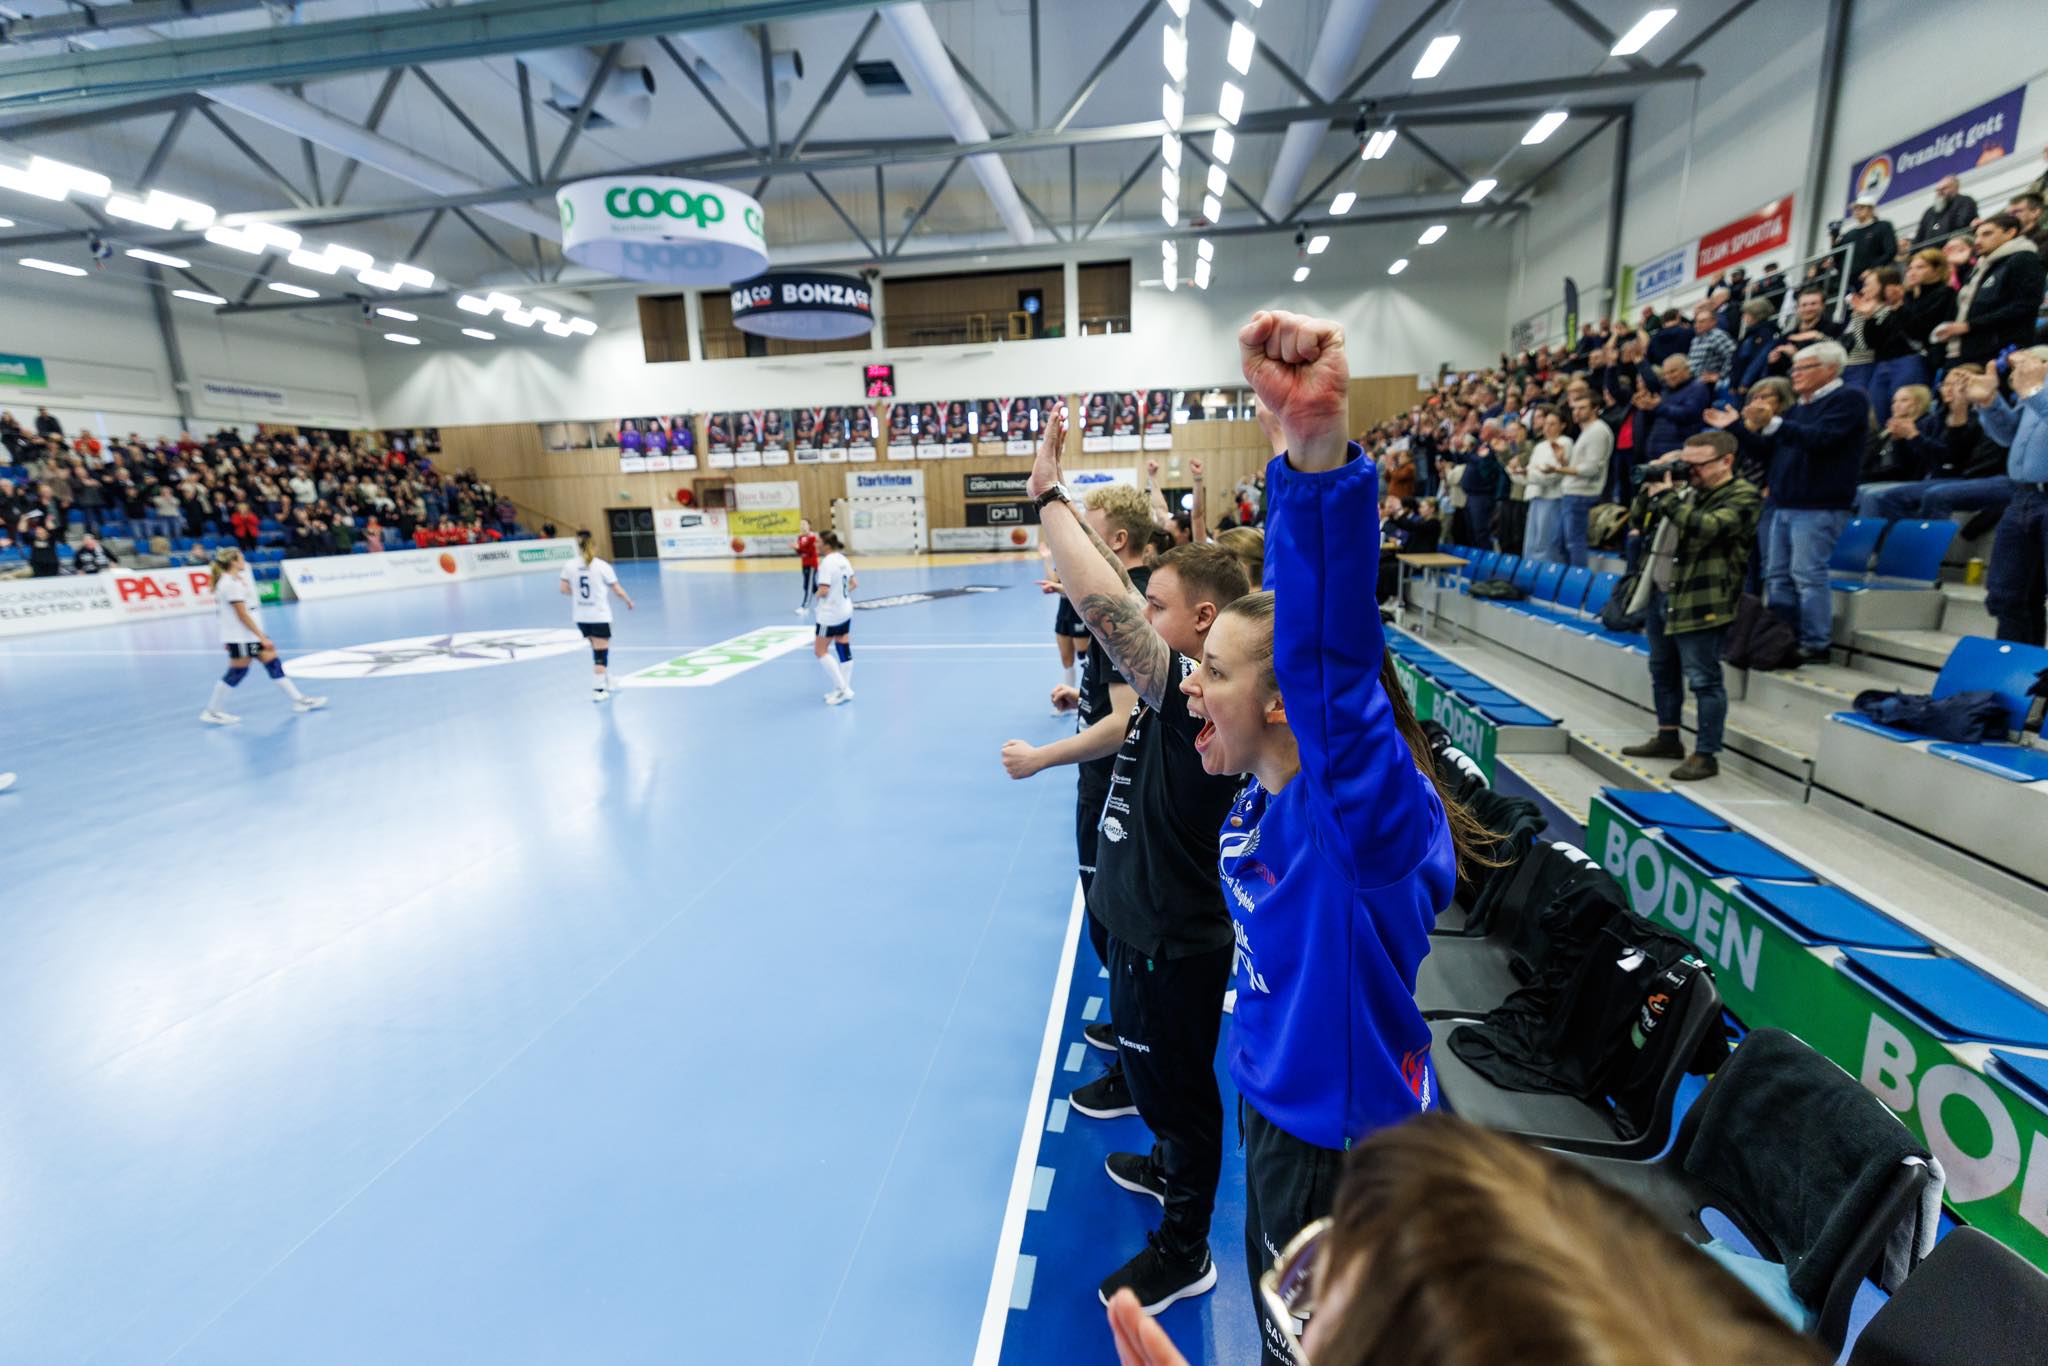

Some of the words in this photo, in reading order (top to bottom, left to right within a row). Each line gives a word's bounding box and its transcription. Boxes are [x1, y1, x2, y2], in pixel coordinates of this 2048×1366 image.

[1964, 111, 2006, 149] gott
[605, 187, 725, 228] coop
[1731, 214, 1784, 254] SPORTIA
[580, 576, 590, 598] 5
[1432, 692, 1484, 760] BODEN
[1604, 818, 1763, 992] BODEN
[1118, 1035, 1150, 1053] Kempa
